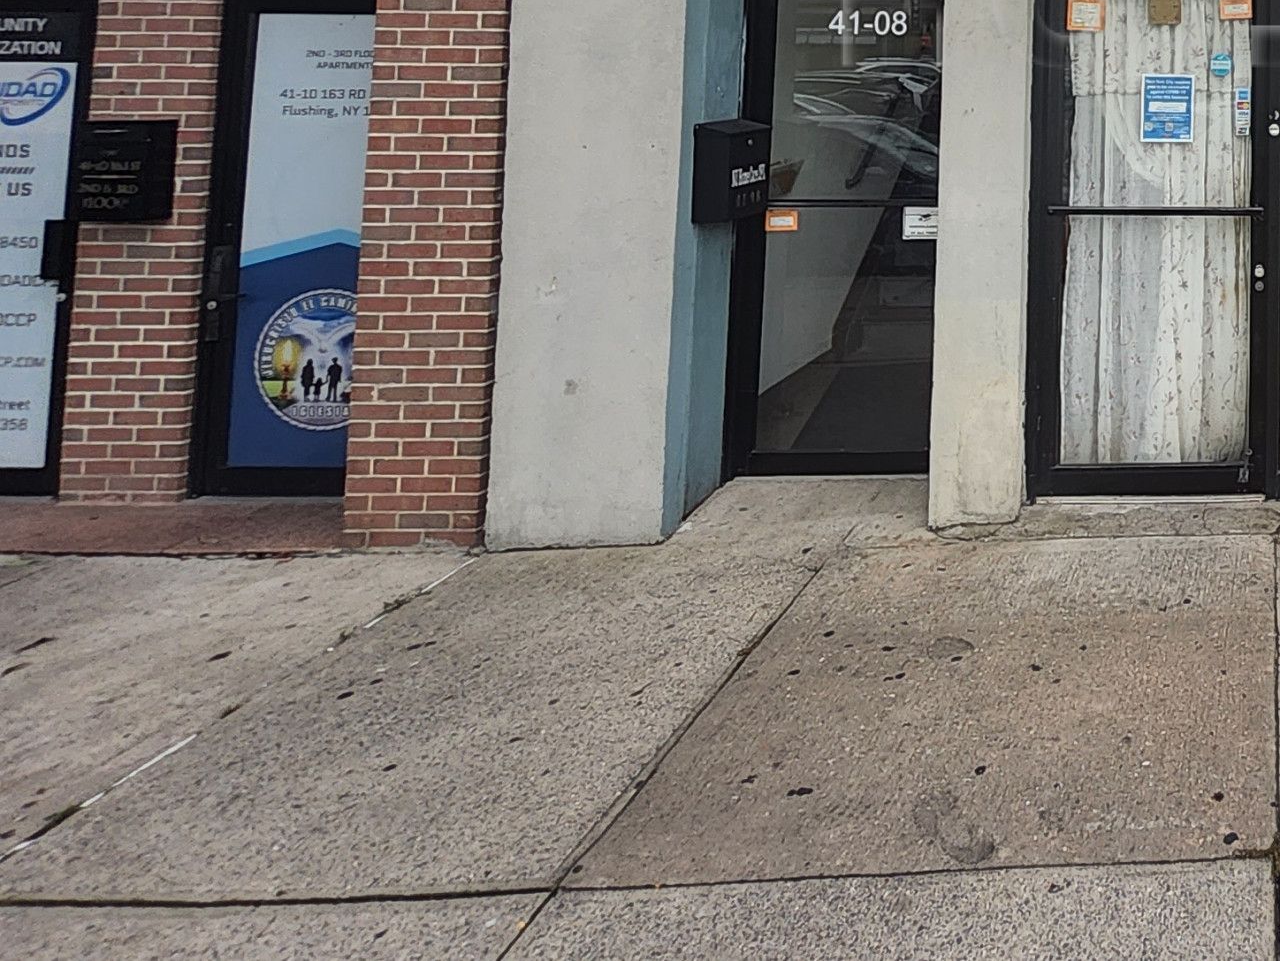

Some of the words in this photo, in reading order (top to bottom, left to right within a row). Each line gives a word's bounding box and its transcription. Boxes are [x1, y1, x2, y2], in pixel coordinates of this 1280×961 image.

[828, 9, 909, 36] 41-08
[279, 88, 317, 99] 41-10
[321, 88, 345, 99] 163
[282, 104, 338, 119] Flushing,
[342, 105, 360, 117] NY
